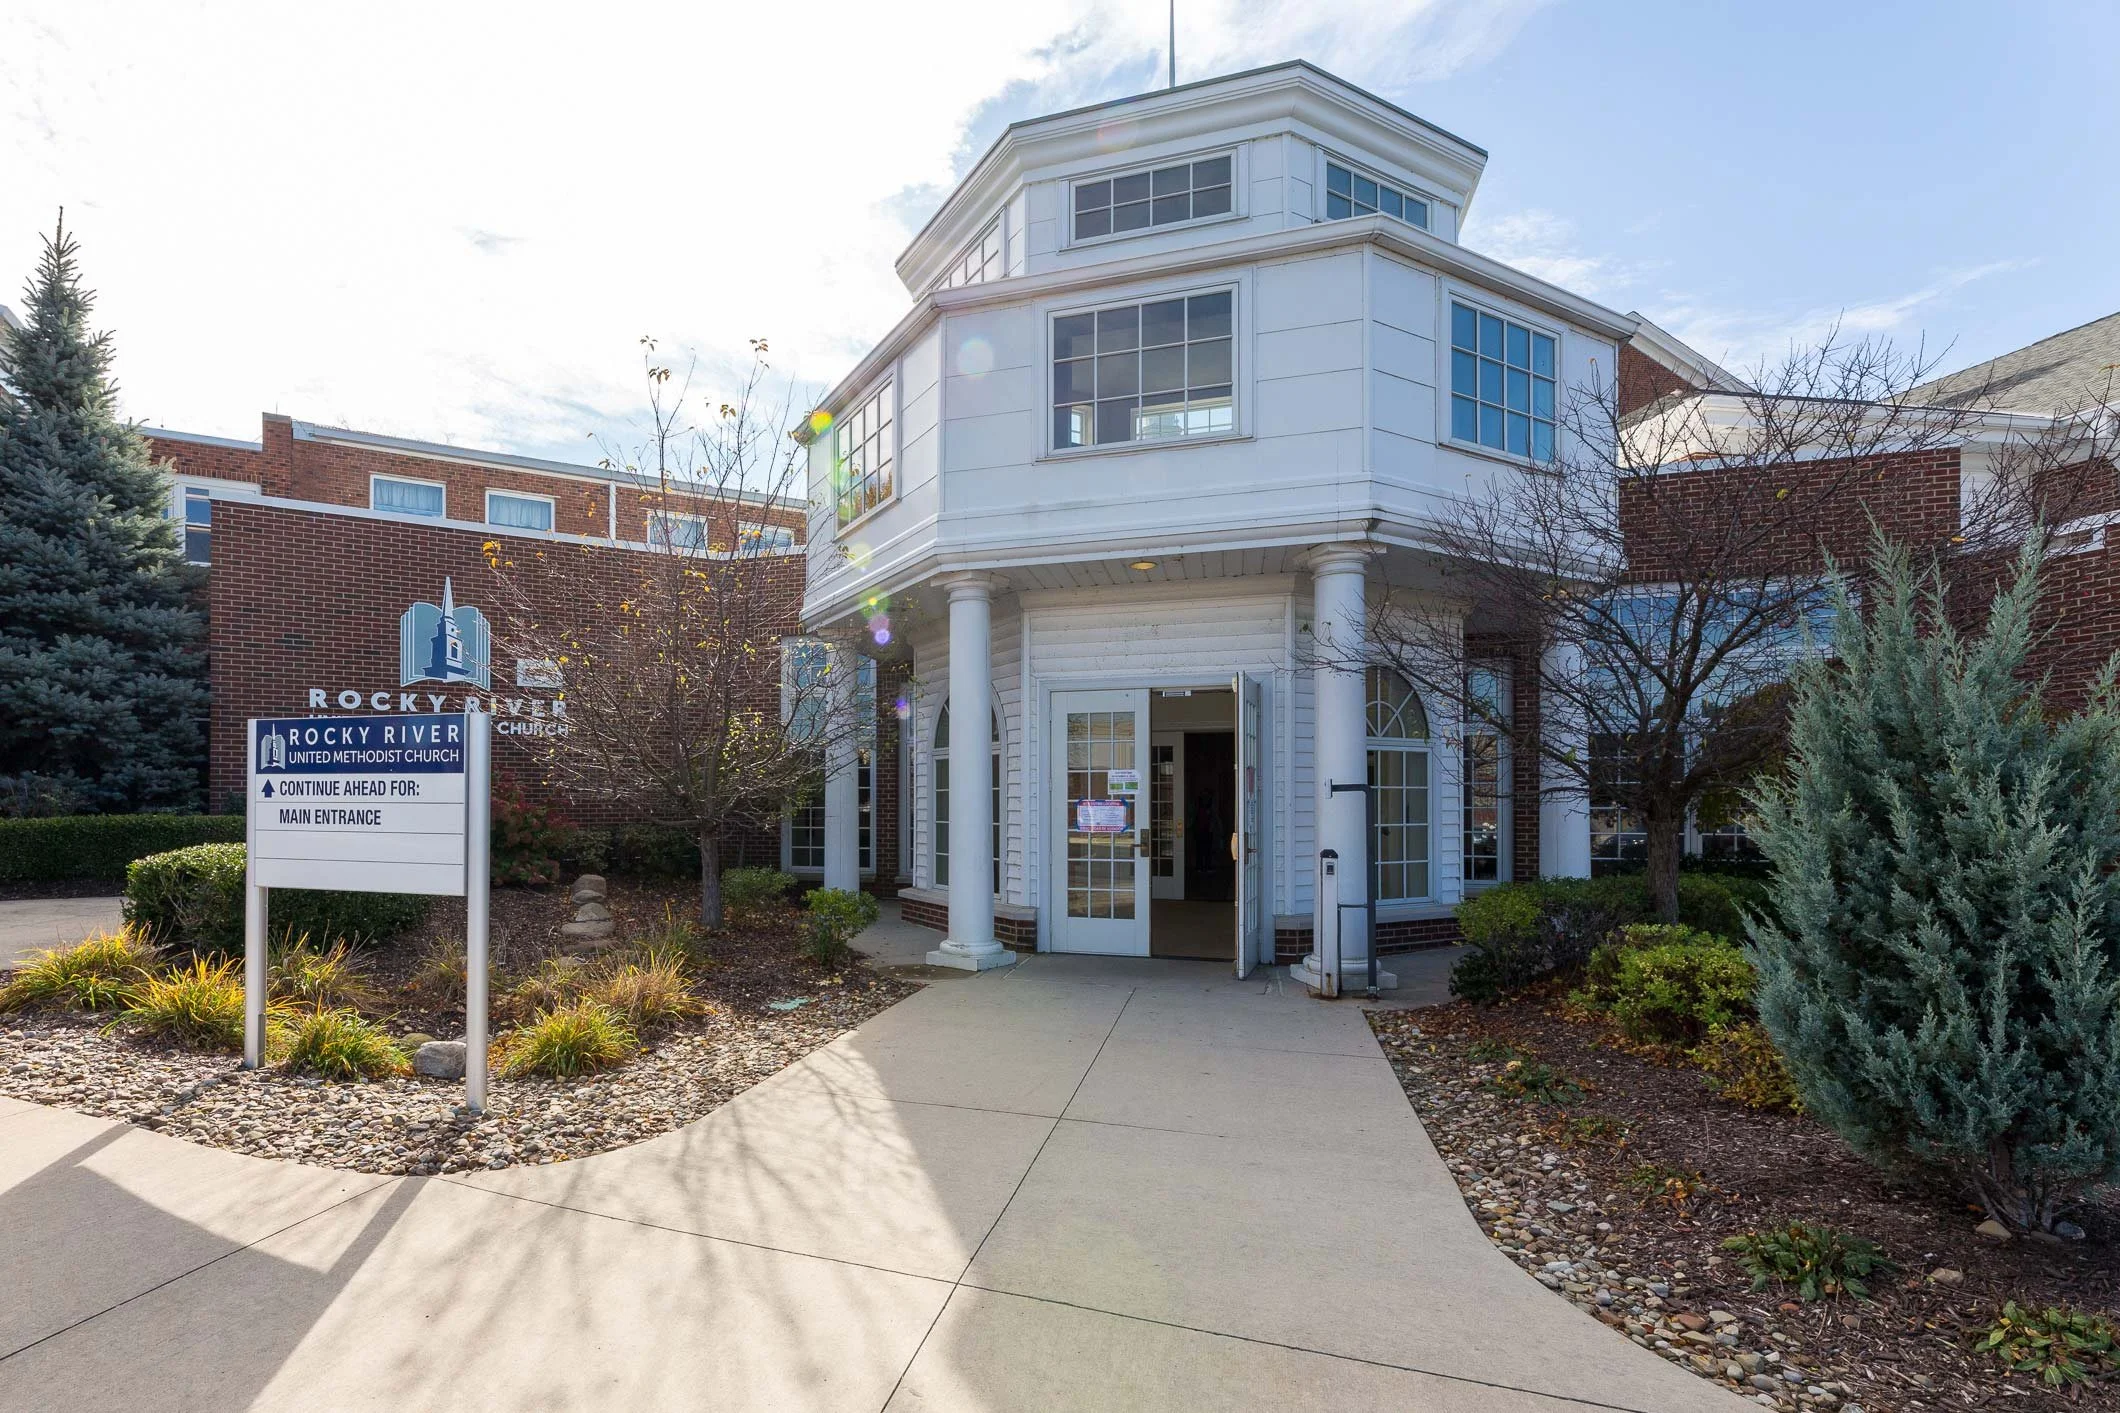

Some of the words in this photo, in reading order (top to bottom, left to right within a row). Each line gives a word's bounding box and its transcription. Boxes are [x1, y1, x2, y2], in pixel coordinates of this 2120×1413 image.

[309, 688, 447, 713] ROCKY
[464, 695, 567, 718] RIVER
[289, 726, 371, 746] ROCKY
[384, 724, 460, 744] RIVER
[497, 721, 569, 736] CHURCH
[289, 751, 331, 764] UNITED
[333, 749, 403, 764] METHODIST
[404, 748, 460, 763] CHURCH
[279, 780, 340, 796] CONTINUE
[344, 780, 387, 796] AHEAD
[390, 780, 420, 797] FOR:
[279, 809, 311, 825] MAIN
[314, 809, 382, 826] ENTRANCE
